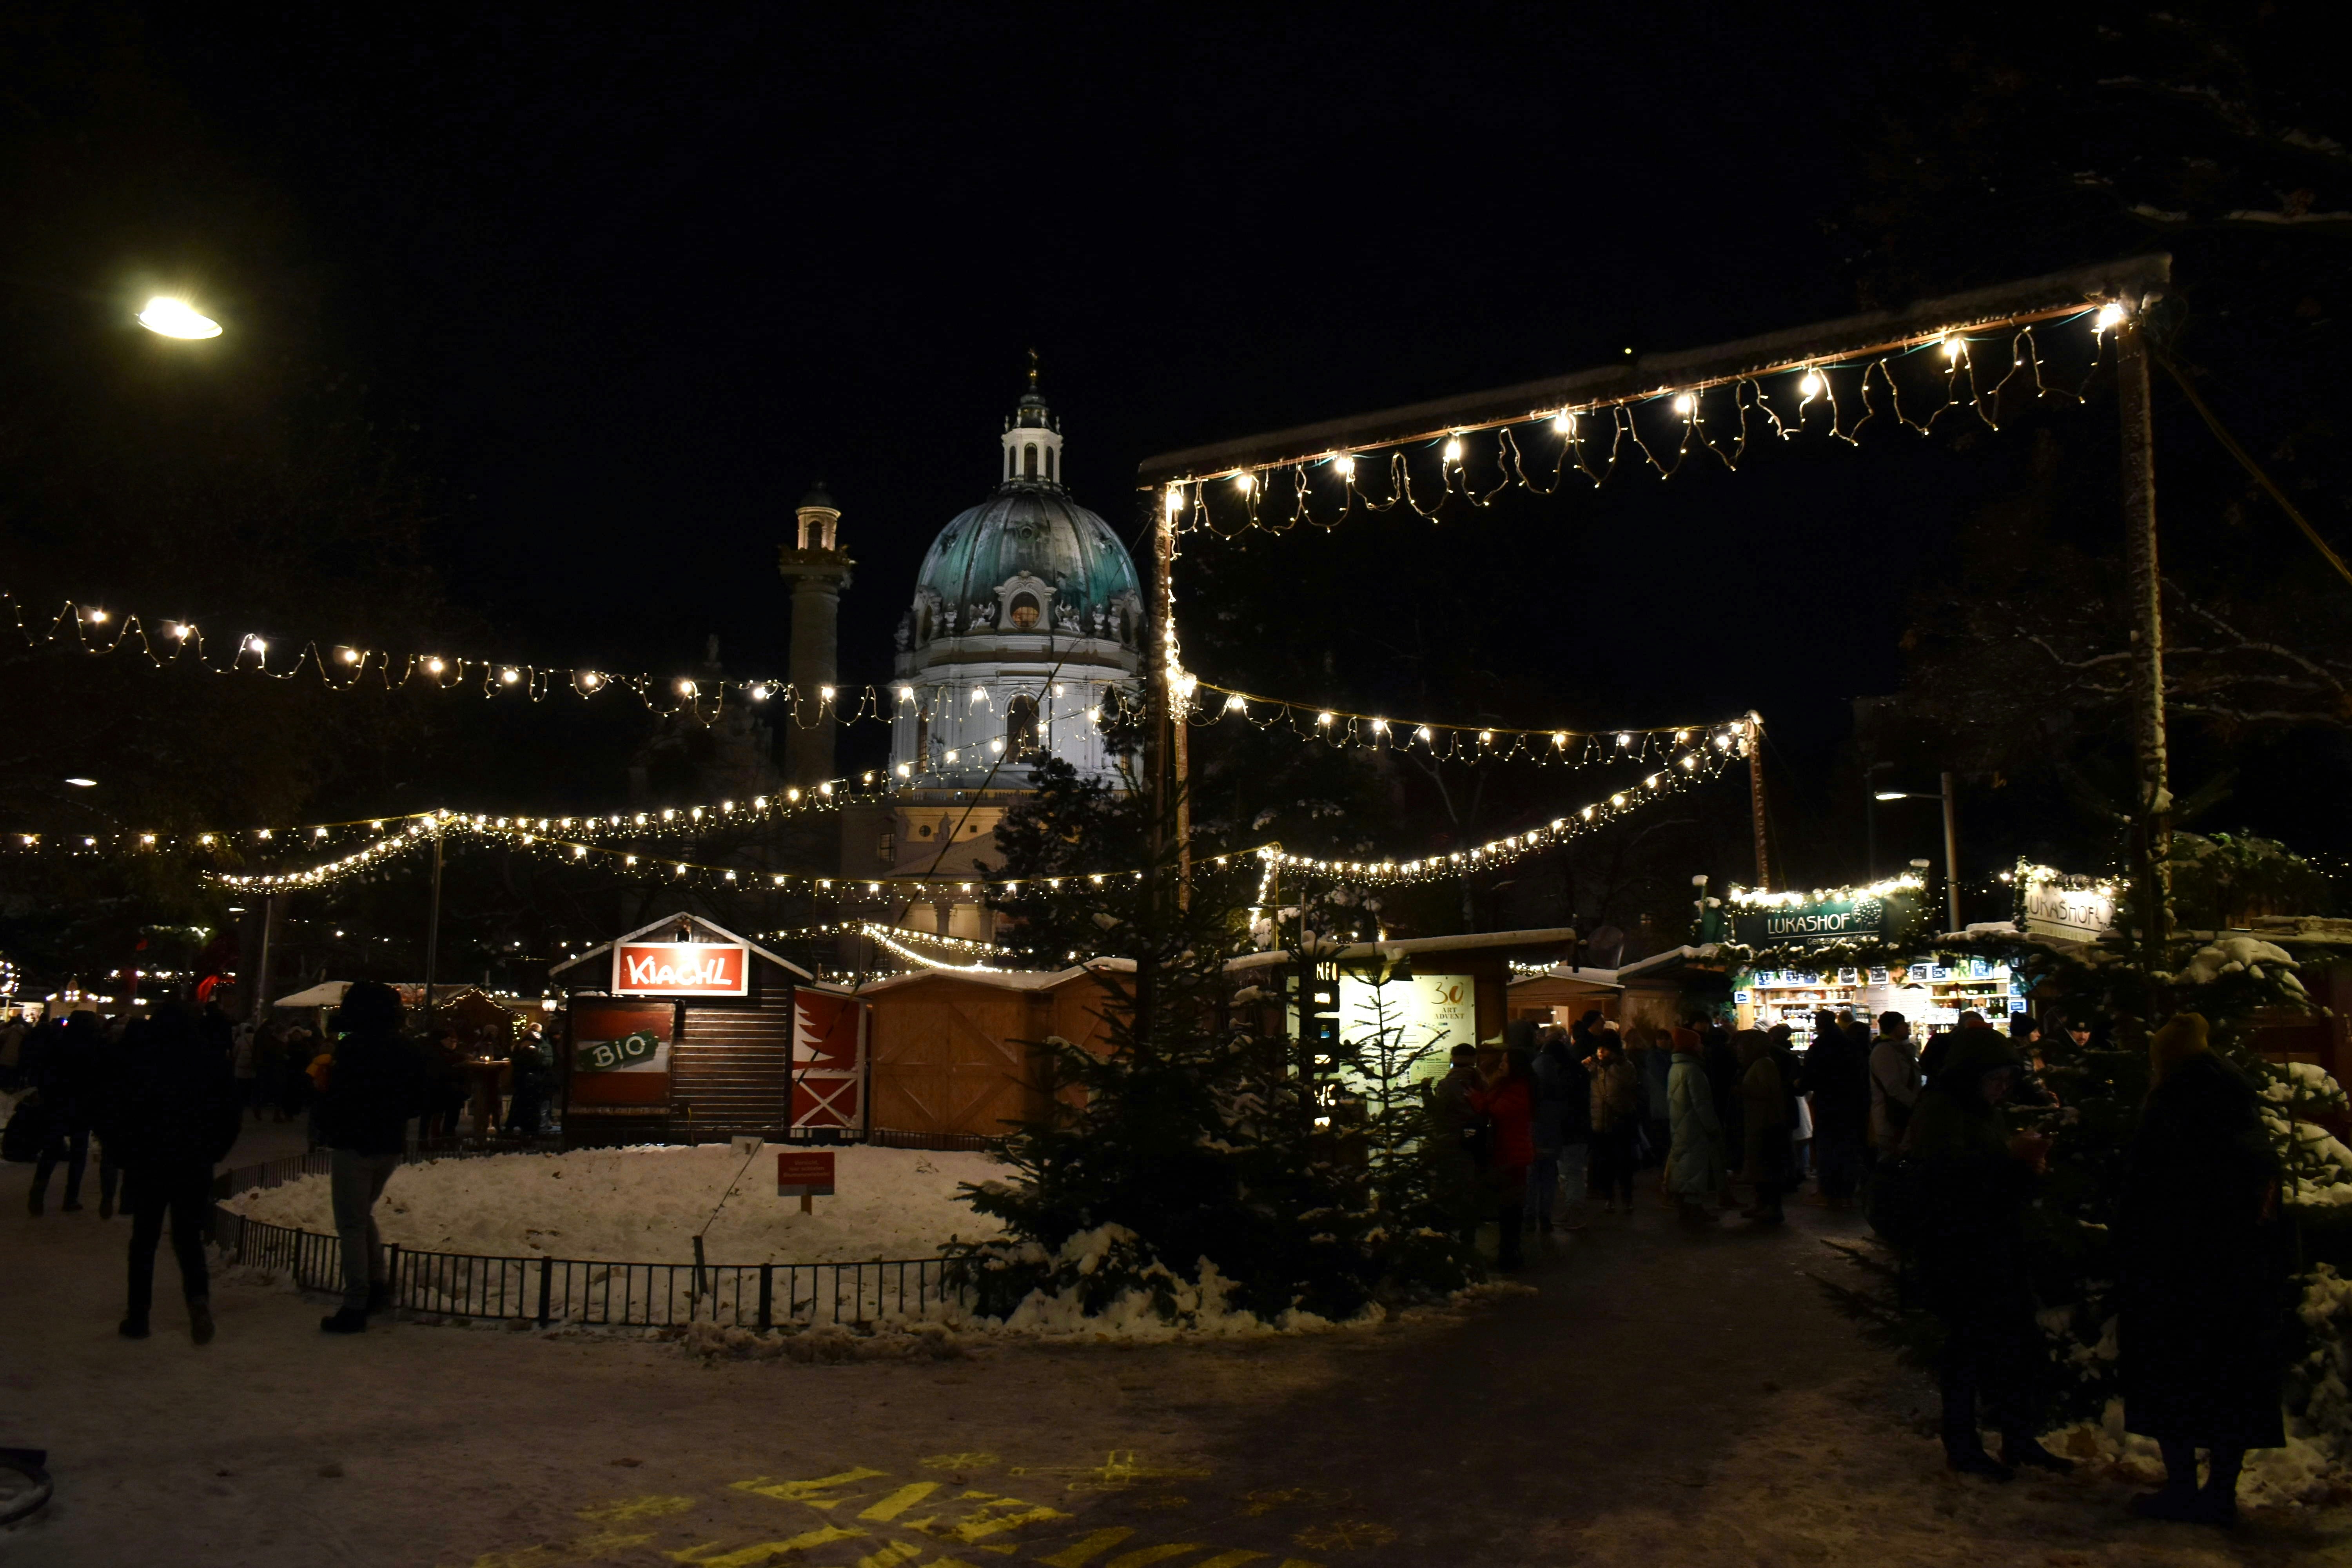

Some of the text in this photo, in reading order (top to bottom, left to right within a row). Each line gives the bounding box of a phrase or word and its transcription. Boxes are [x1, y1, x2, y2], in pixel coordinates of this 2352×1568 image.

[2029, 895, 2094, 925] UKASHOF
[1768, 913, 1850, 934] LUKASHOF
[1316, 961, 1337, 981] NFO
[1431, 982, 1464, 1004] 30
